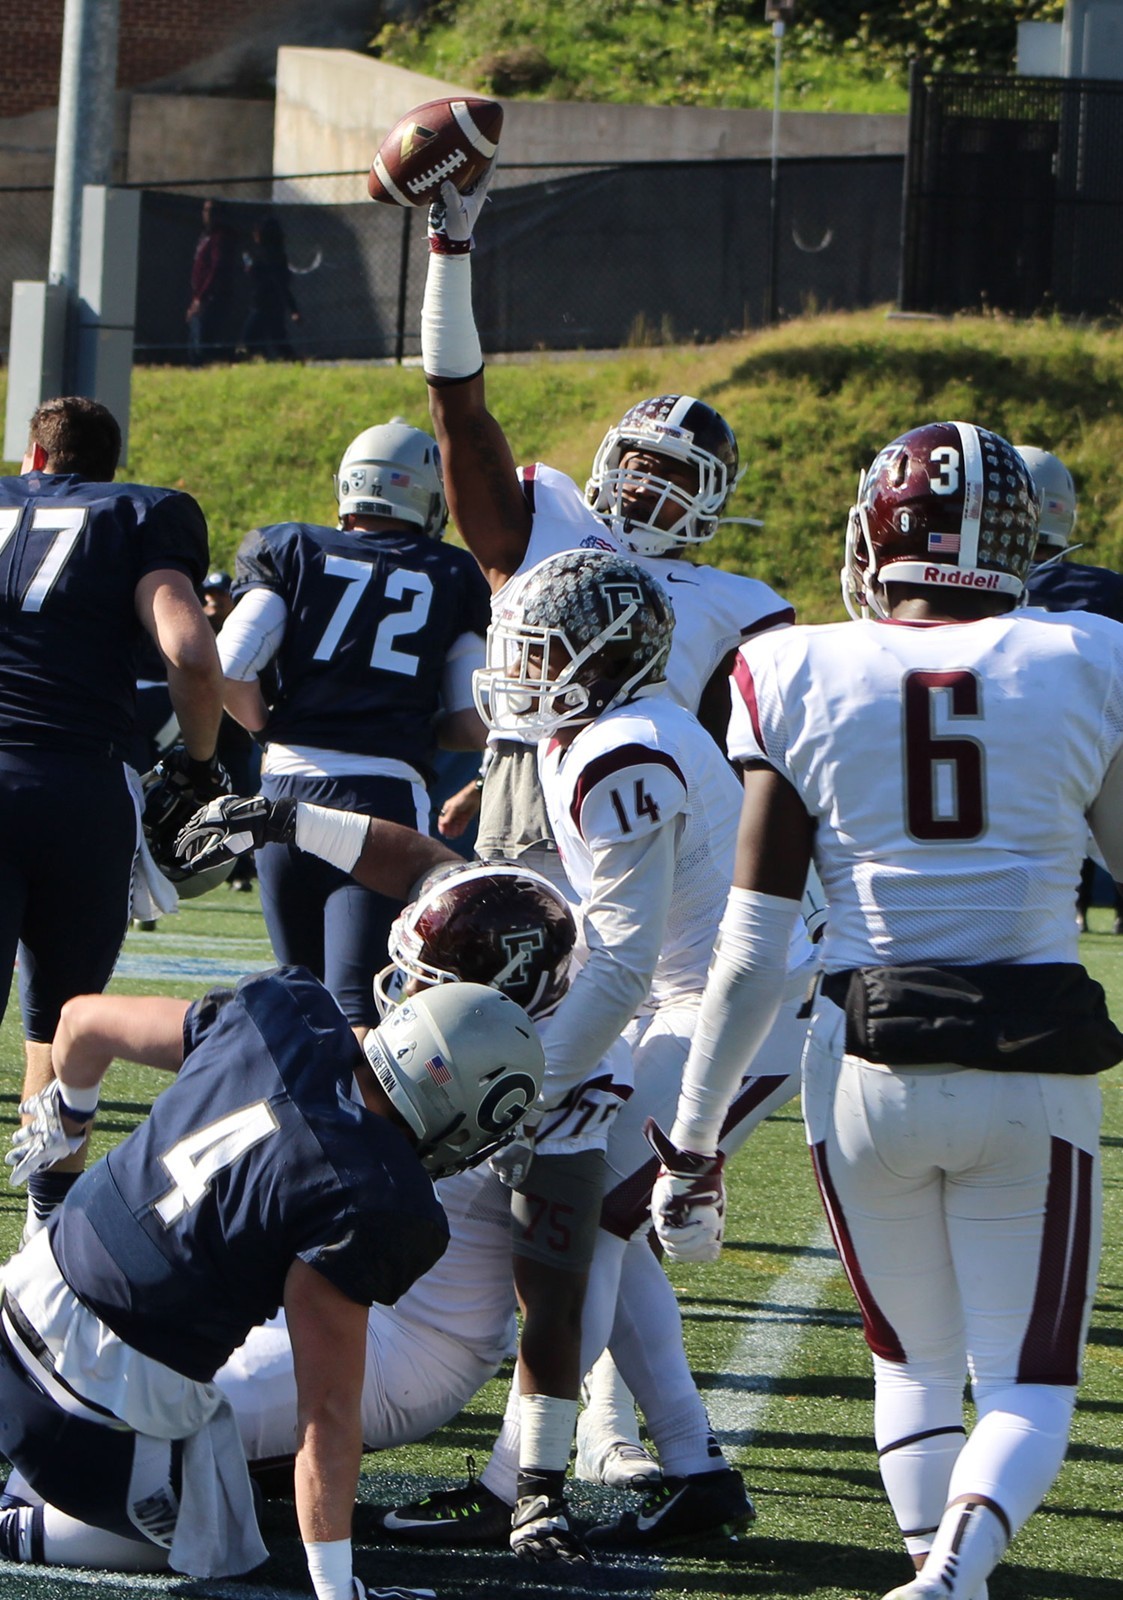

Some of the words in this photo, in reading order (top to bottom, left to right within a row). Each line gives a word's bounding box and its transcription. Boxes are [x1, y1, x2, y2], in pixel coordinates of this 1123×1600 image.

[371, 484, 382, 497] 72
[930, 446, 960, 495] 3
[0, 507, 88, 613] 7
[924, 566, 1000, 590] Riddell
[313, 555, 434, 677] 72
[601, 582, 643, 641] F
[902, 666, 989, 846] 6
[609, 778, 660, 834] 14
[502, 928, 544, 986] F
[366, 1043, 398, 1094] GEORGETOWN
[396, 1047, 410, 1060] 4
[476, 1071, 536, 1134] G
[149, 1098, 281, 1230] 4
[523, 1193, 575, 1253] 75
